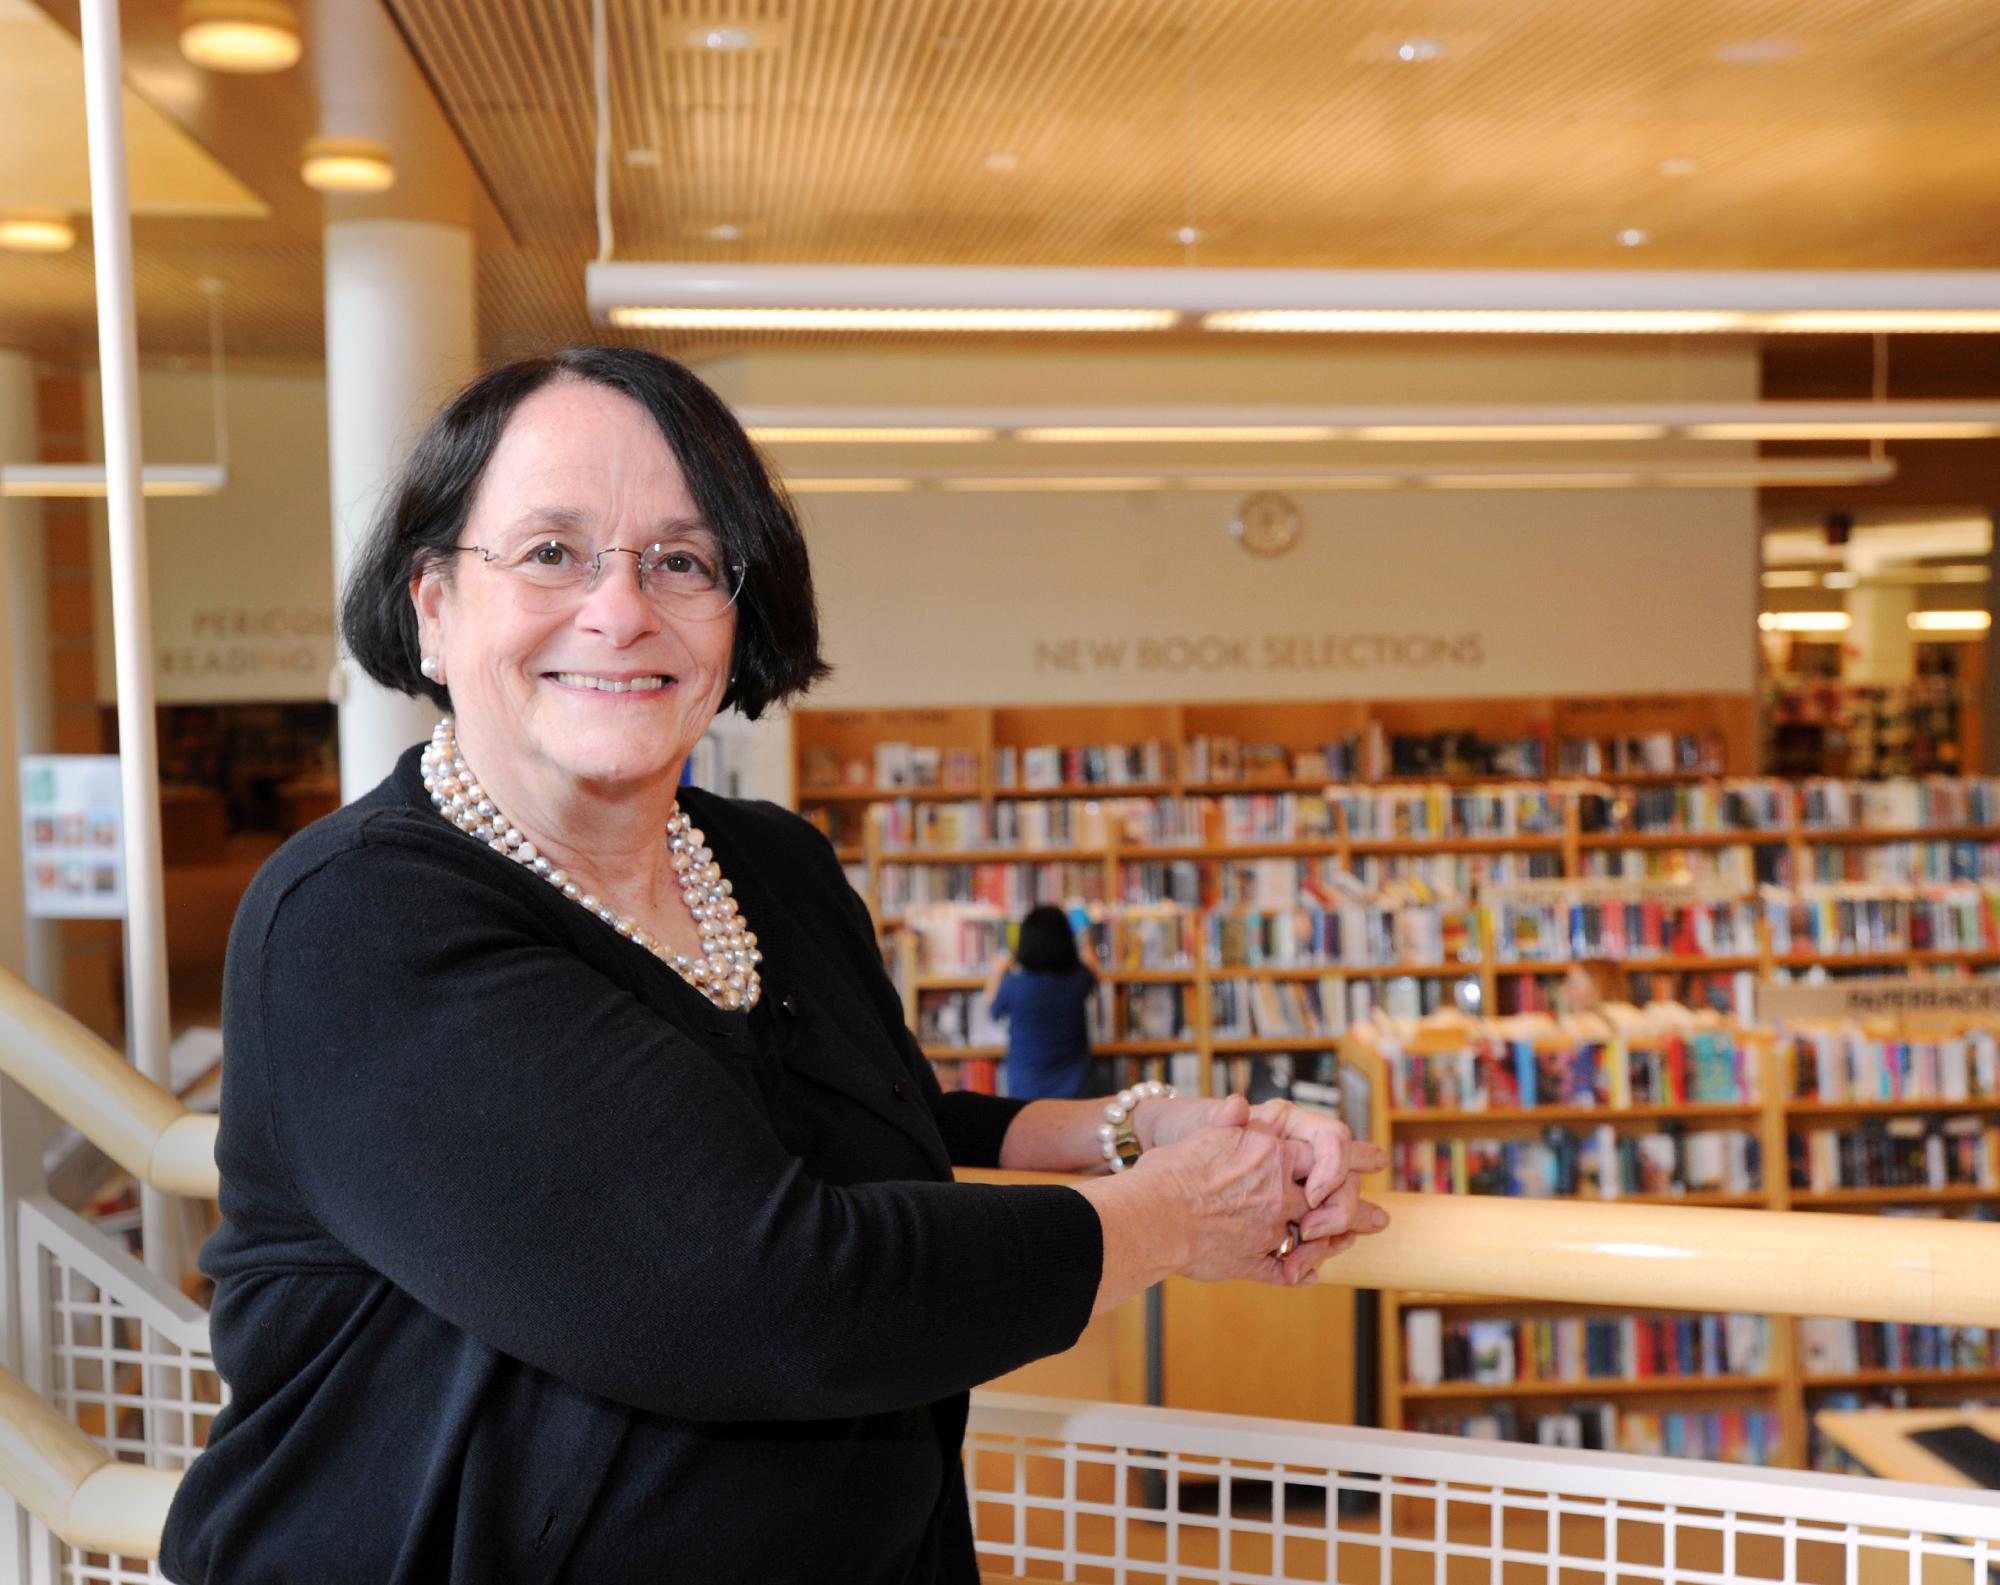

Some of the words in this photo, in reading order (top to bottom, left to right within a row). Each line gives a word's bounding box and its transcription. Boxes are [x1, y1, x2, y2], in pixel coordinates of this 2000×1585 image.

[1034, 637, 1127, 673] NEW
[1136, 635, 1252, 672] BOOK
[1261, 631, 1486, 671] SELECTIONS
